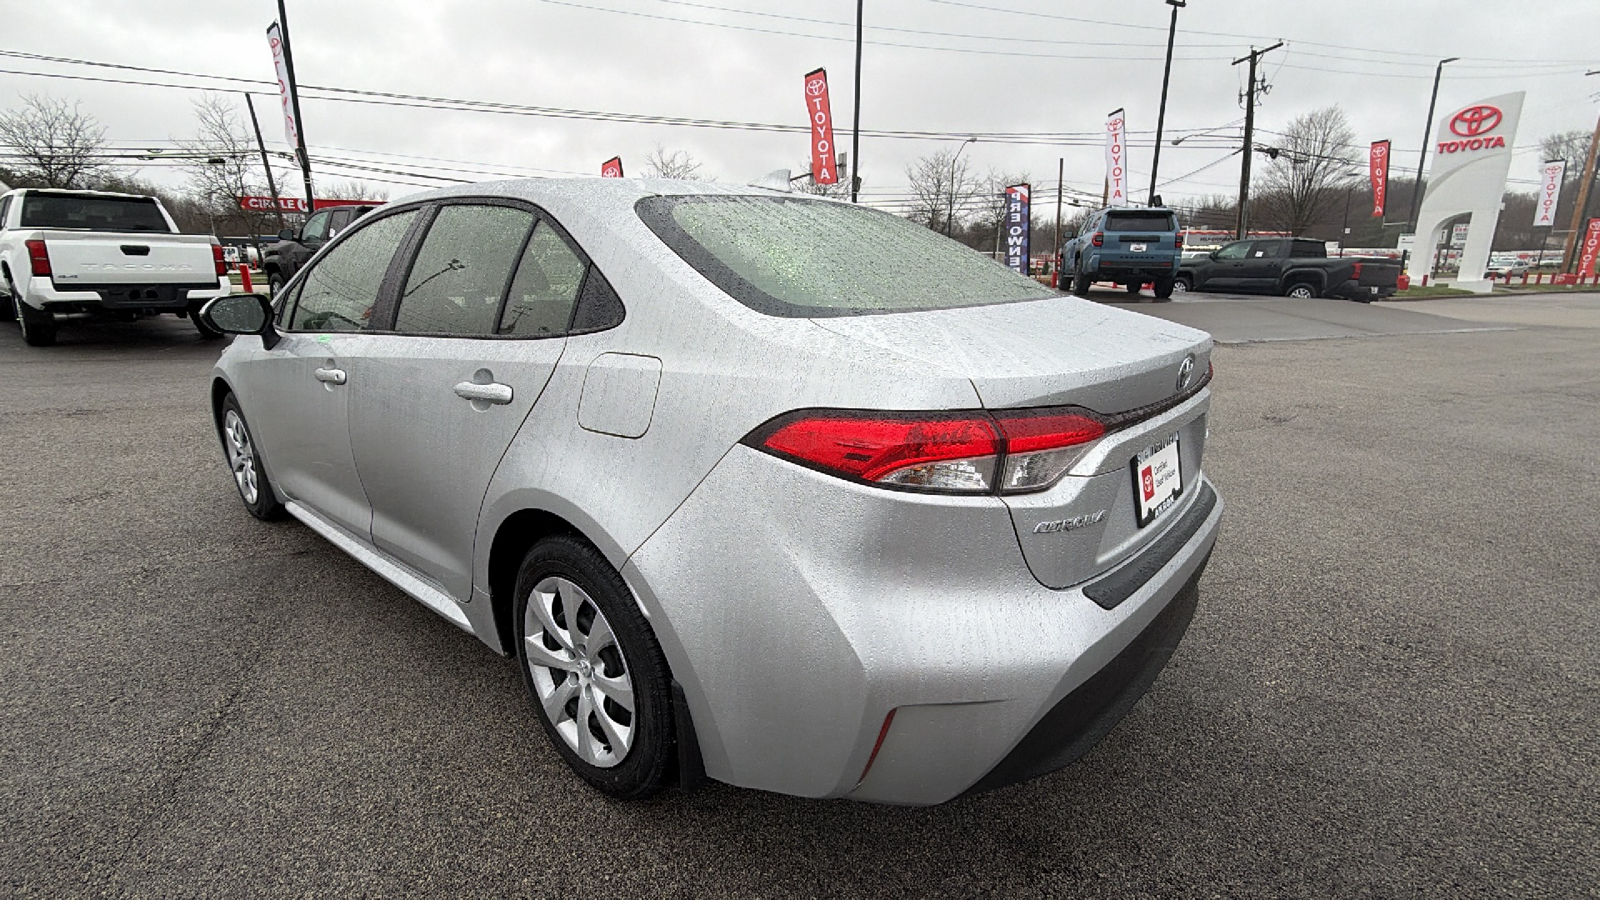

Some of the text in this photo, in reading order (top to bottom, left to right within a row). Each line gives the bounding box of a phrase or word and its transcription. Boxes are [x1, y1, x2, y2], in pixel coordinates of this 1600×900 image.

[813, 98, 831, 179] TOYOTA
[1438, 136, 1505, 154] TOYOTA
[1111, 133, 1122, 198] TOYOTA
[1540, 176, 1556, 221] TOYOTA
[81, 263, 193, 271] TACOMA
